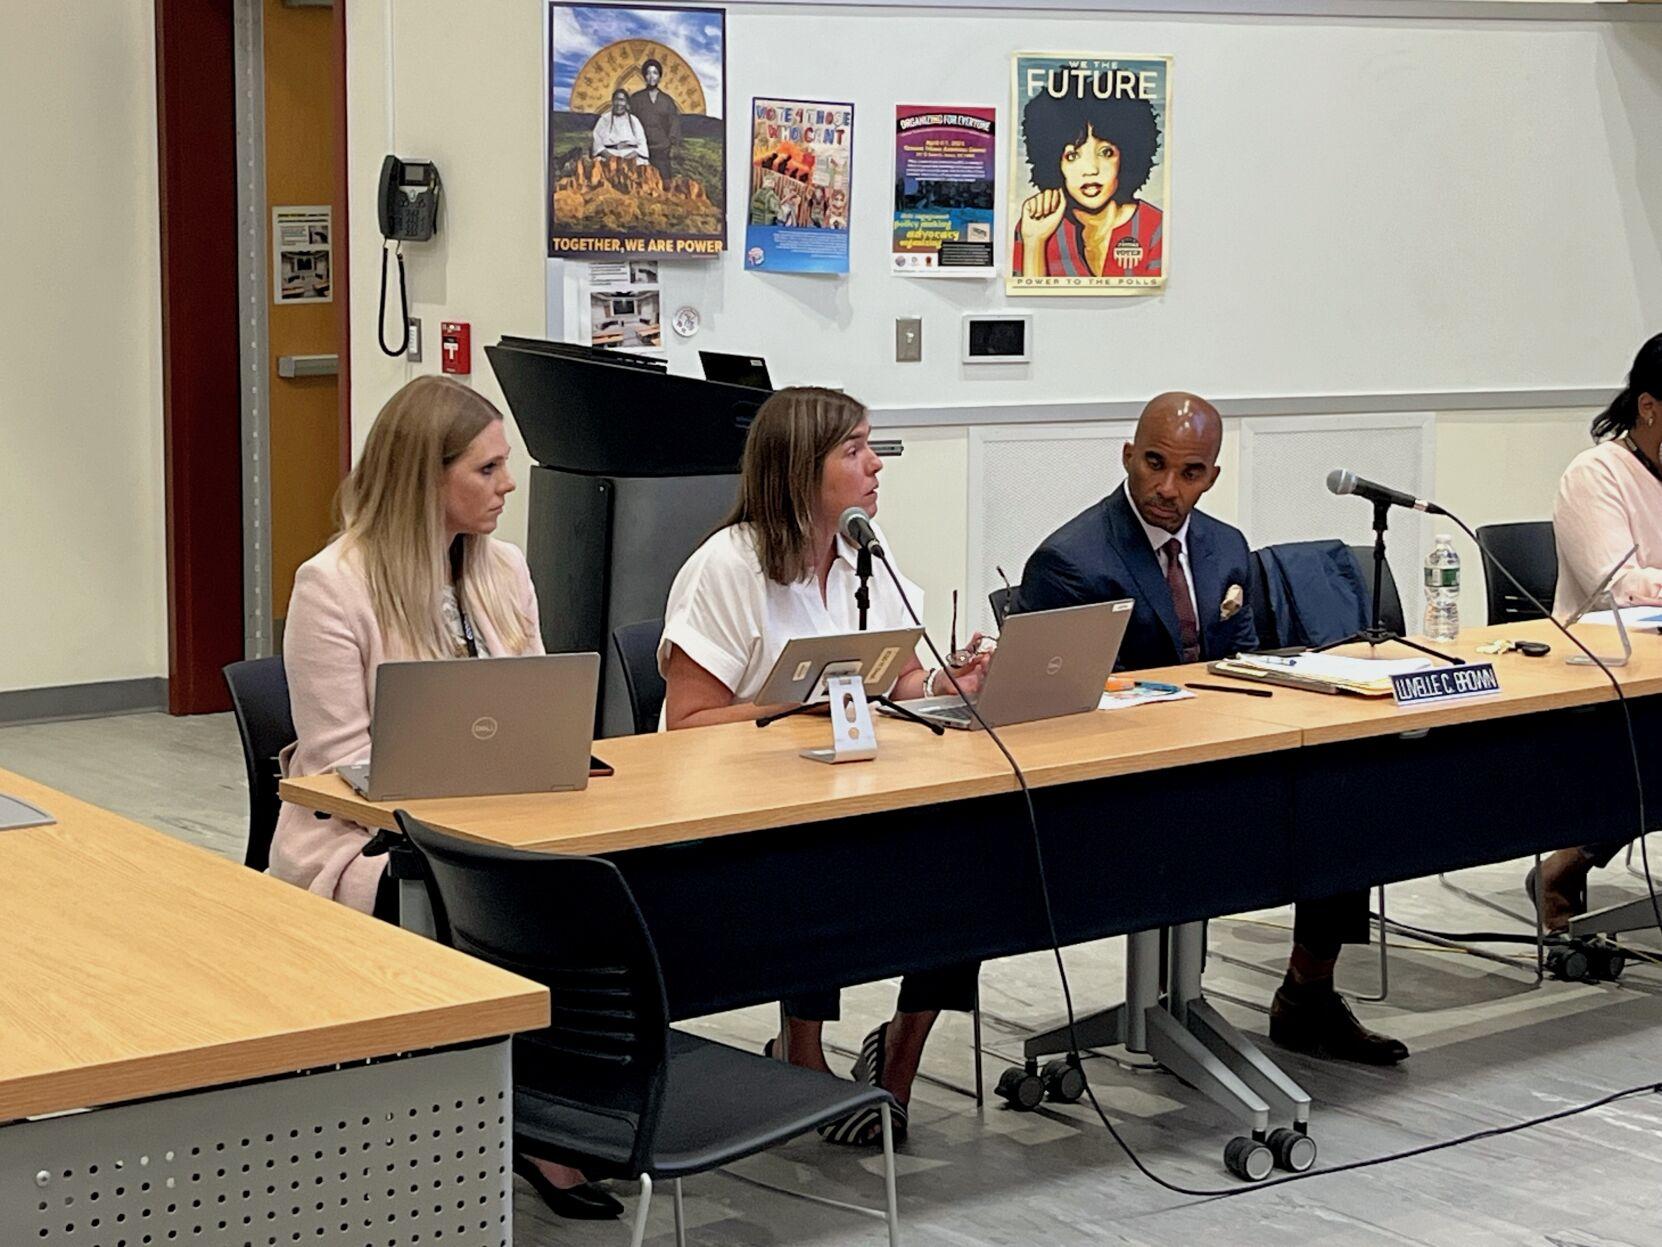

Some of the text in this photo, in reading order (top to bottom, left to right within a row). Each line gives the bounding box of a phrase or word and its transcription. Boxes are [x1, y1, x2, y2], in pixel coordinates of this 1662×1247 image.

[1068, 60, 1118, 69] WE THE
[1027, 68, 1158, 99] FUTURE
[756, 104, 793, 123] VOTE
[806, 108, 850, 126] THOSE
[900, 114, 991, 132] ORGANIZING FOR EVERYONE
[767, 124, 801, 141] WHO
[553, 237, 723, 253] TOGETHER, WE ARE POWER
[1453, 668, 1497, 693] BROWN
